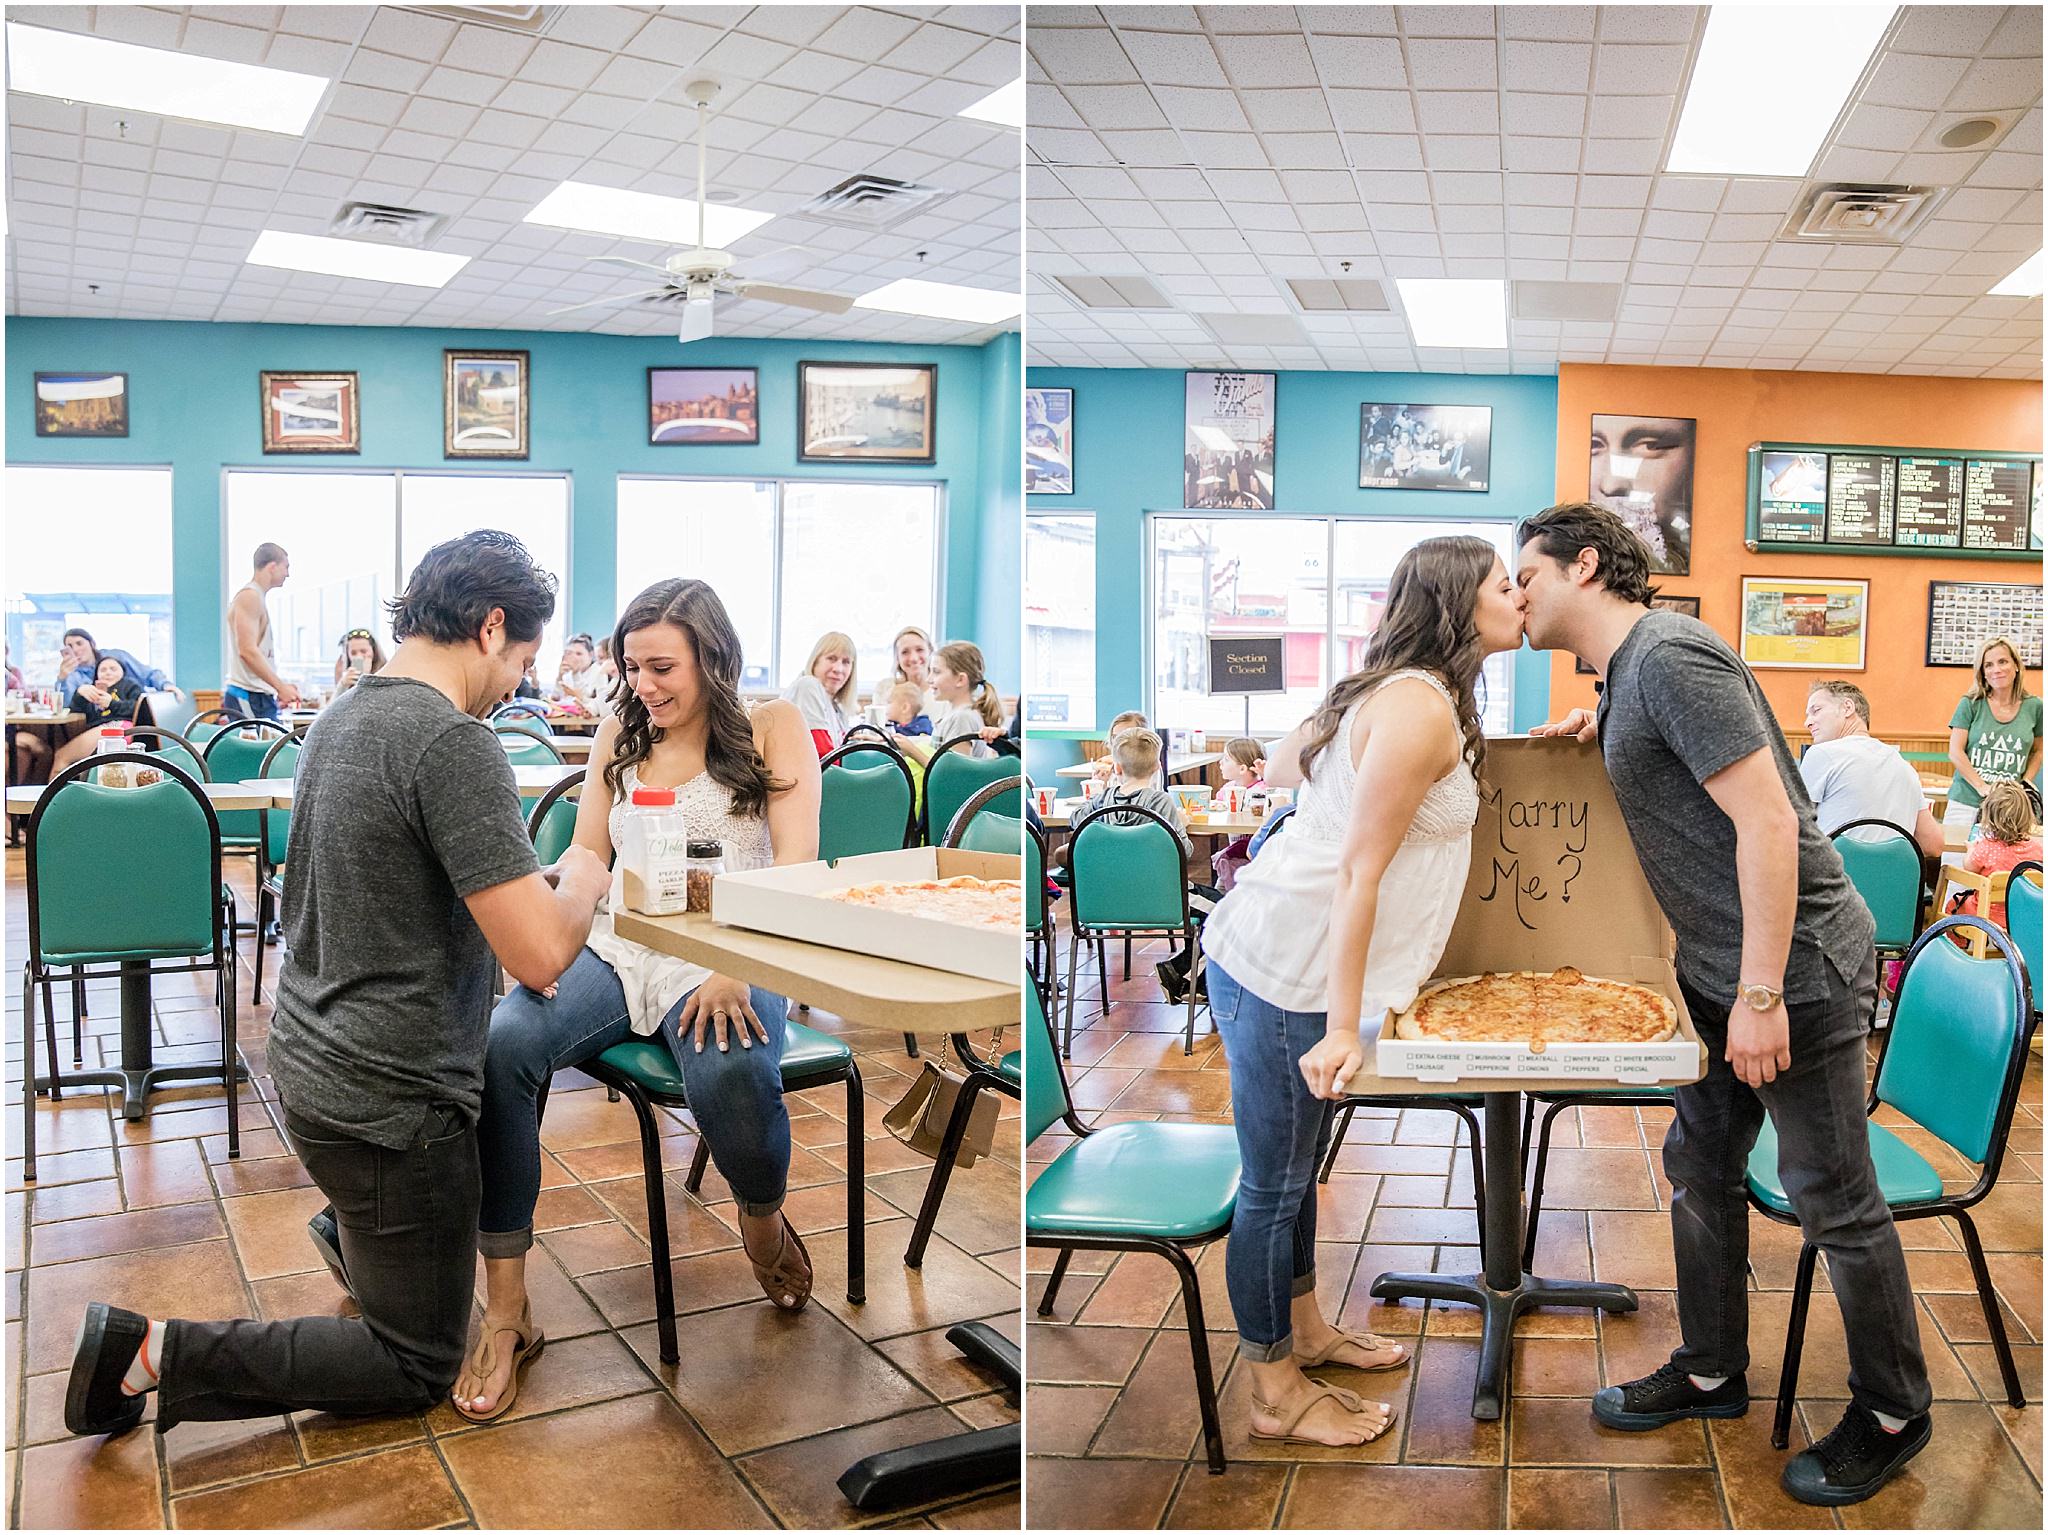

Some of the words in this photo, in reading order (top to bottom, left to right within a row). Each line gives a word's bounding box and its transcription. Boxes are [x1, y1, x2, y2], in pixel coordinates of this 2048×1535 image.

[1226, 654, 1267, 663] Section
[1228, 665, 1266, 674] Closed
[1971, 747, 2026, 772] HAPPY
[1476, 788, 1588, 854] Marry
[1479, 854, 1582, 930] Me?
